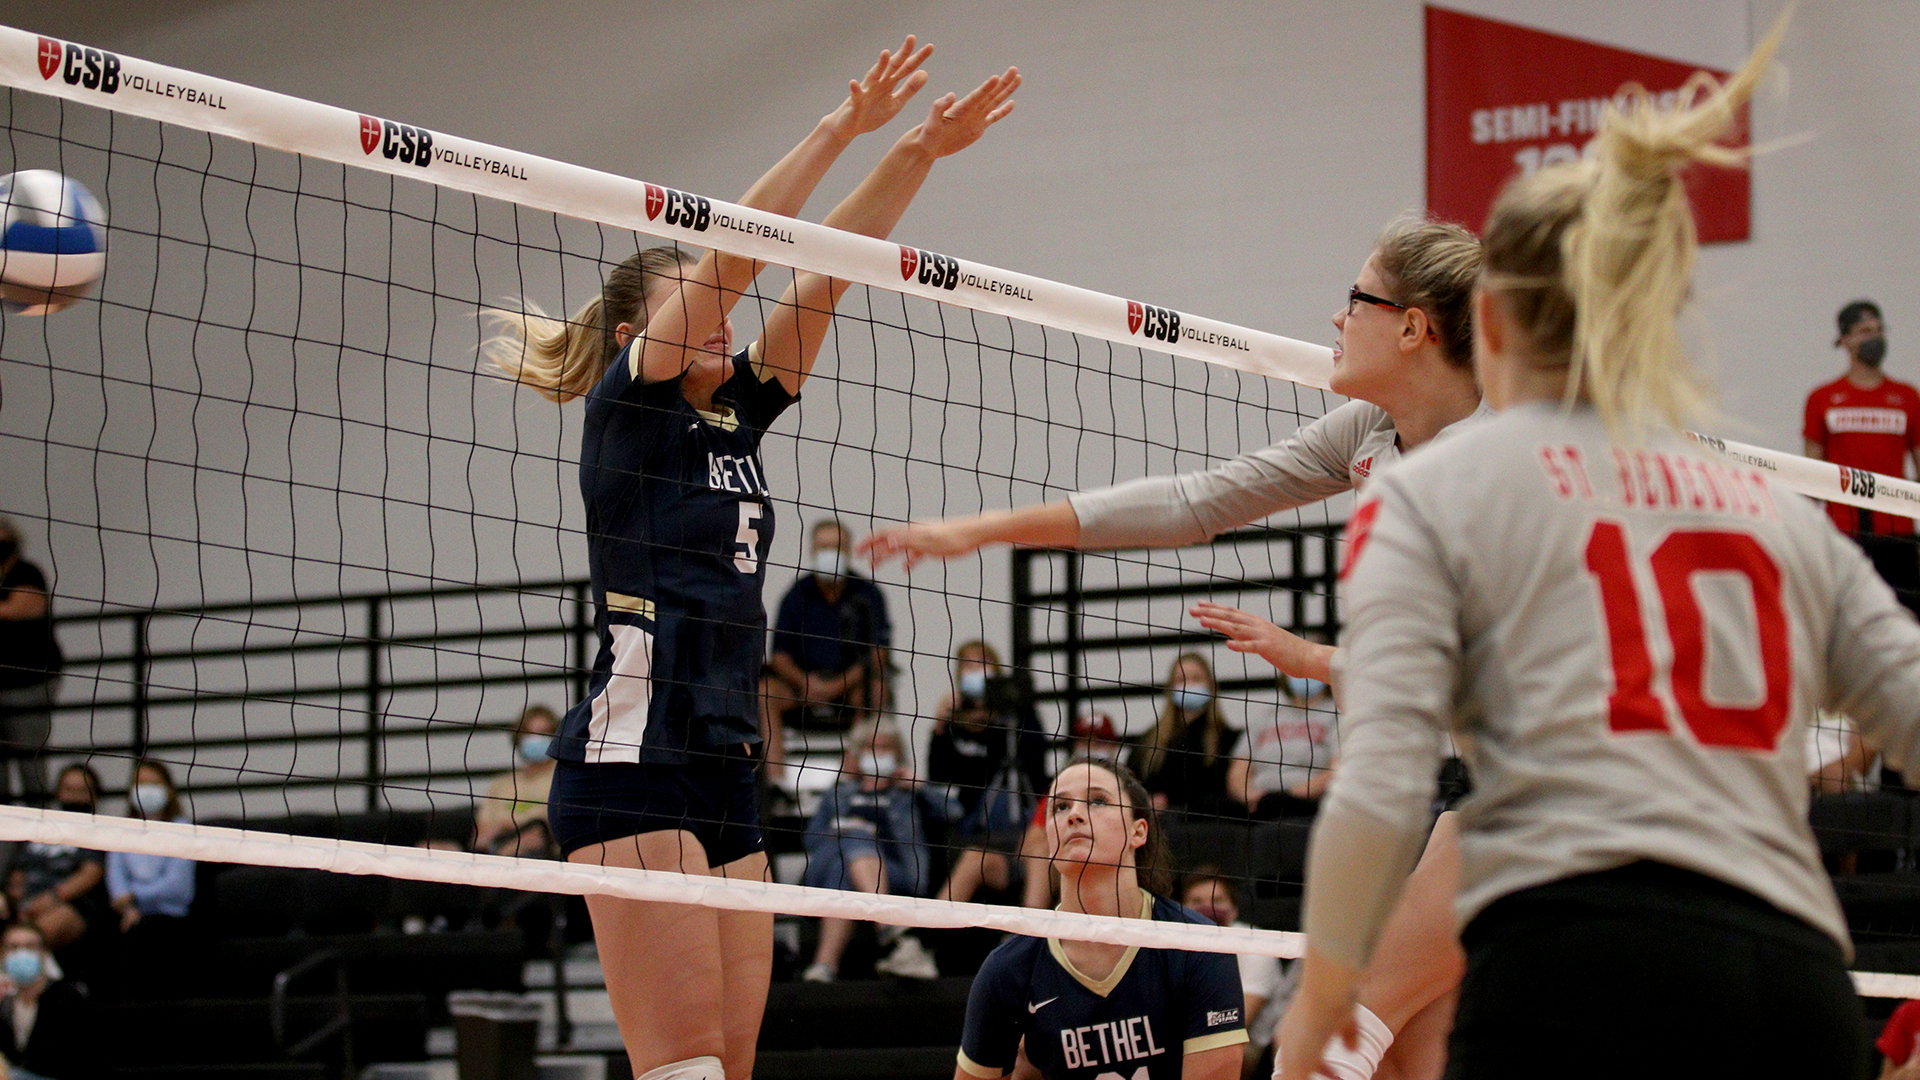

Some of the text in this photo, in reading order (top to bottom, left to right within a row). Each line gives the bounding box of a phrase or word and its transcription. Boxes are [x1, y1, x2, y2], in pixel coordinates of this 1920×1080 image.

[63, 43, 227, 110] CSB VOLLEYBALL
[382, 120, 528, 181] CSB VOLLEYBALL
[665, 188, 795, 244] CSB VOLLEYBALL
[918, 249, 1034, 301] CSB VOLLEYBALL
[1143, 305, 1250, 351] CSB VOLLEYBALL
[1851, 468, 1876, 499] CSB
[733, 501, 764, 574] 5
[1585, 519, 1791, 752] 10
[1061, 1015, 1166, 1069] BETHEL
